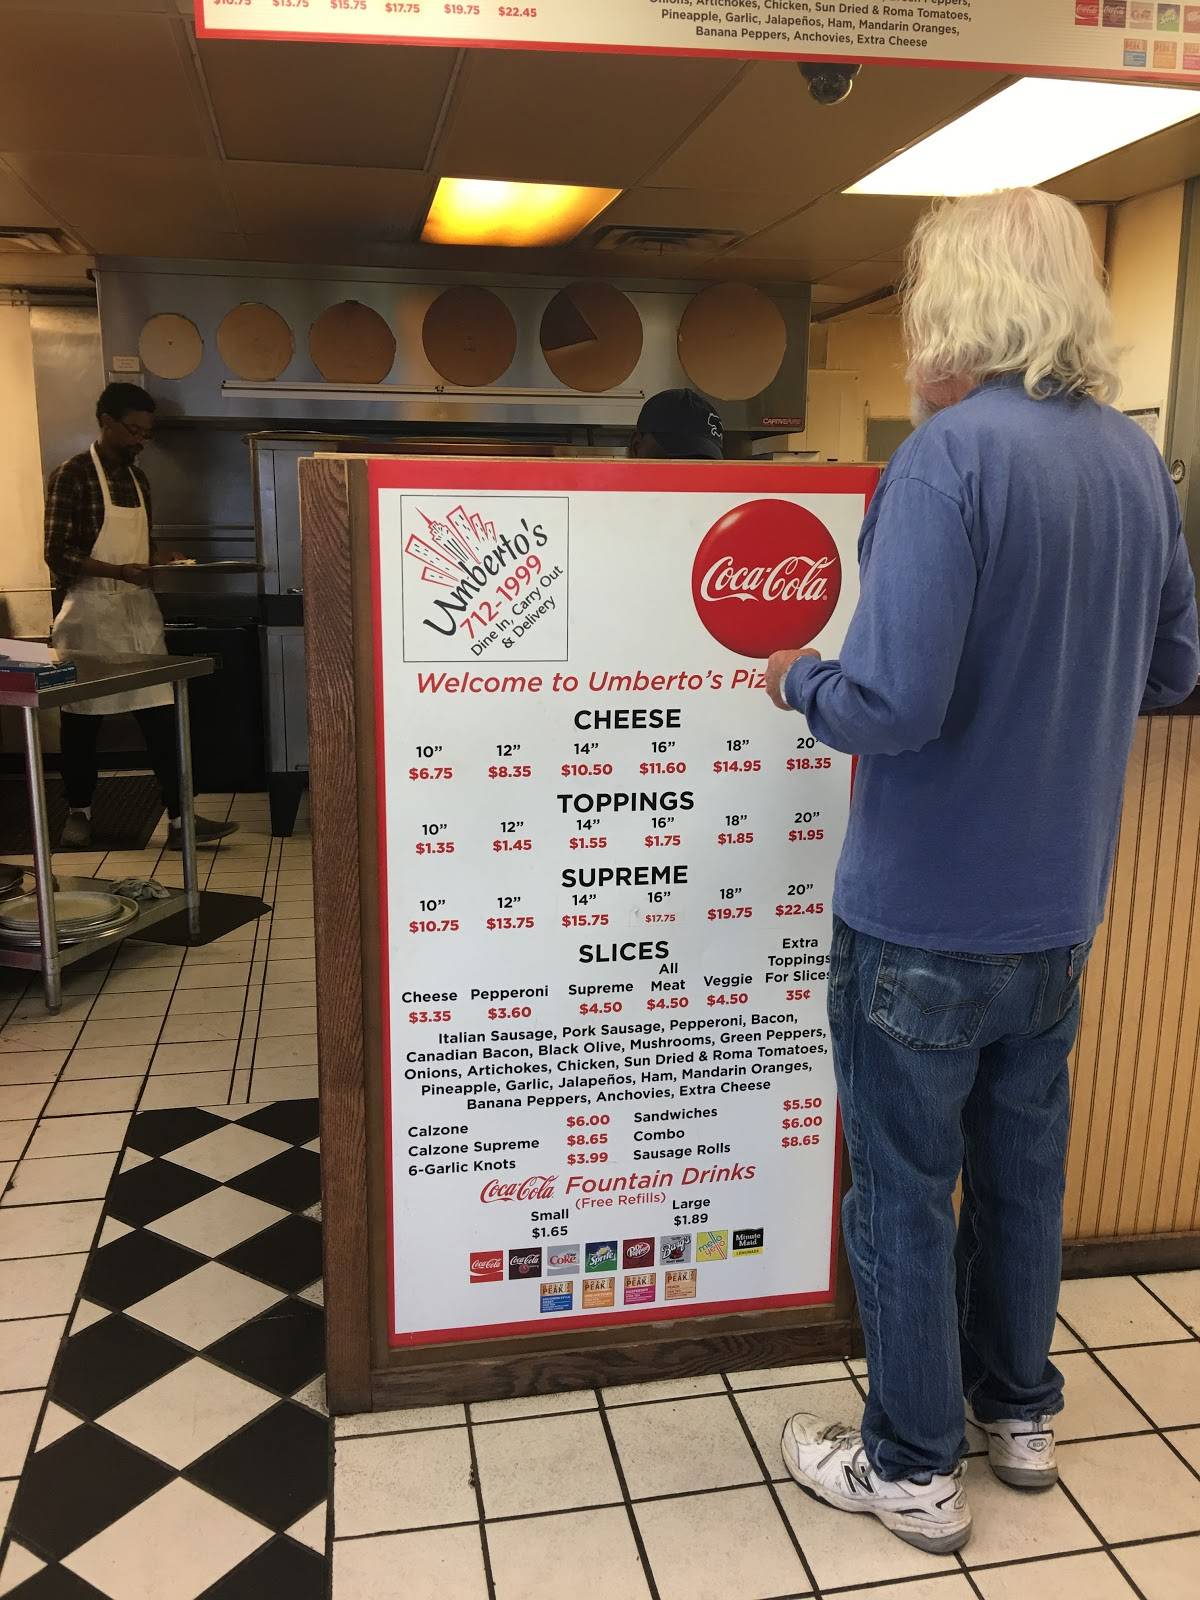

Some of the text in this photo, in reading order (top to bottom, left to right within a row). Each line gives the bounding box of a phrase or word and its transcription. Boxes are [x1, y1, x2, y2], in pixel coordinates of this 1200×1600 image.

[385, 3, 536, 18] $17.75 $19.75 $22.45
[815, 2, 972, 22] Sun Dried & Roma Tomatoes,
[662, 9, 959, 36] Pineapple, Garlic, Jalapeños, Ham, Mandarin Oranges,
[696, 26, 927, 47] Banana Peppers, Anchovies, Extra Cheese
[701, 556, 836, 602] Coca-Cola
[460, 555, 542, 639] 712-1999
[471, 566, 563, 656] Dine In, Carry Out
[502, 596, 556, 648] & Delivery
[418, 672, 542, 693] Welcome
[553, 673, 578, 692] to
[574, 709, 681, 730] CHEESE
[409, 758, 831, 781] $6.75 $8.35 $10.50 $11.60 $14.95 $18.35
[557, 791, 694, 813] TOPPINGS
[416, 829, 824, 855] $1.35 $1.45 $1.55 $1.75 $1.85 $1.95
[561, 865, 688, 888] SUPREME
[409, 903, 823, 934] $10.75 $13.75 $15.75 $17.75 $19.75 $22.45
[579, 941, 669, 963] SLICES
[783, 938, 818, 949] Extra
[659, 962, 678, 975] All
[768, 954, 830, 969] Toppings
[651, 979, 685, 992] Meat
[704, 973, 752, 987] Veggie
[766, 972, 789, 983] For
[402, 991, 458, 1003] Cheese
[471, 985, 548, 1001] Pepperoni
[568, 983, 633, 997] Supreme
[409, 989, 811, 1024] $3.35 $3.60 $4.50 $4.50 $4.50 35¢
[439, 1014, 797, 1044] Italian Sausage, Pork Sausage, Pepperoni, Bacon,
[406, 1028, 826, 1063] Canadian Bacon, Black Olive, Mushrooms, Green Peppers,
[404, 1044, 827, 1080] Onions, Artichokes, Chicken, Sun Dried & Roma Tomatoes,
[422, 1062, 812, 1096] Pineapple, Garlic, Jalapeños, Ham, Mandarin Oranges,
[467, 1081, 771, 1110] Banana Peppers, Anchovies, Extra Cheese
[783, 1098, 822, 1112] $5.50
[567, 1114, 610, 1128] $6.00
[634, 1108, 717, 1123] Sandwiches
[782, 1116, 822, 1130] $6.00
[408, 1125, 468, 1137] Calzone
[634, 1129, 685, 1141] Combo
[408, 1140, 539, 1157] Calzone Supreme
[567, 1133, 608, 1147] $8.65
[782, 1134, 819, 1148] $8.65
[567, 1152, 608, 1166] $3.99
[633, 1143, 730, 1160] Sausage Rolls
[409, 1159, 516, 1176] 6-Garlic Knots
[565, 1170, 673, 1194] Fountain
[681, 1163, 756, 1185] Drinks
[576, 1192, 666, 1210] (Free Refills)
[673, 1199, 710, 1210] Large
[531, 1208, 569, 1221] Small
[674, 1213, 708, 1227] $1.89
[532, 1225, 568, 1239] $1.65
[736, 1232, 760, 1241] Minute
[739, 1239, 757, 1247] Maid
